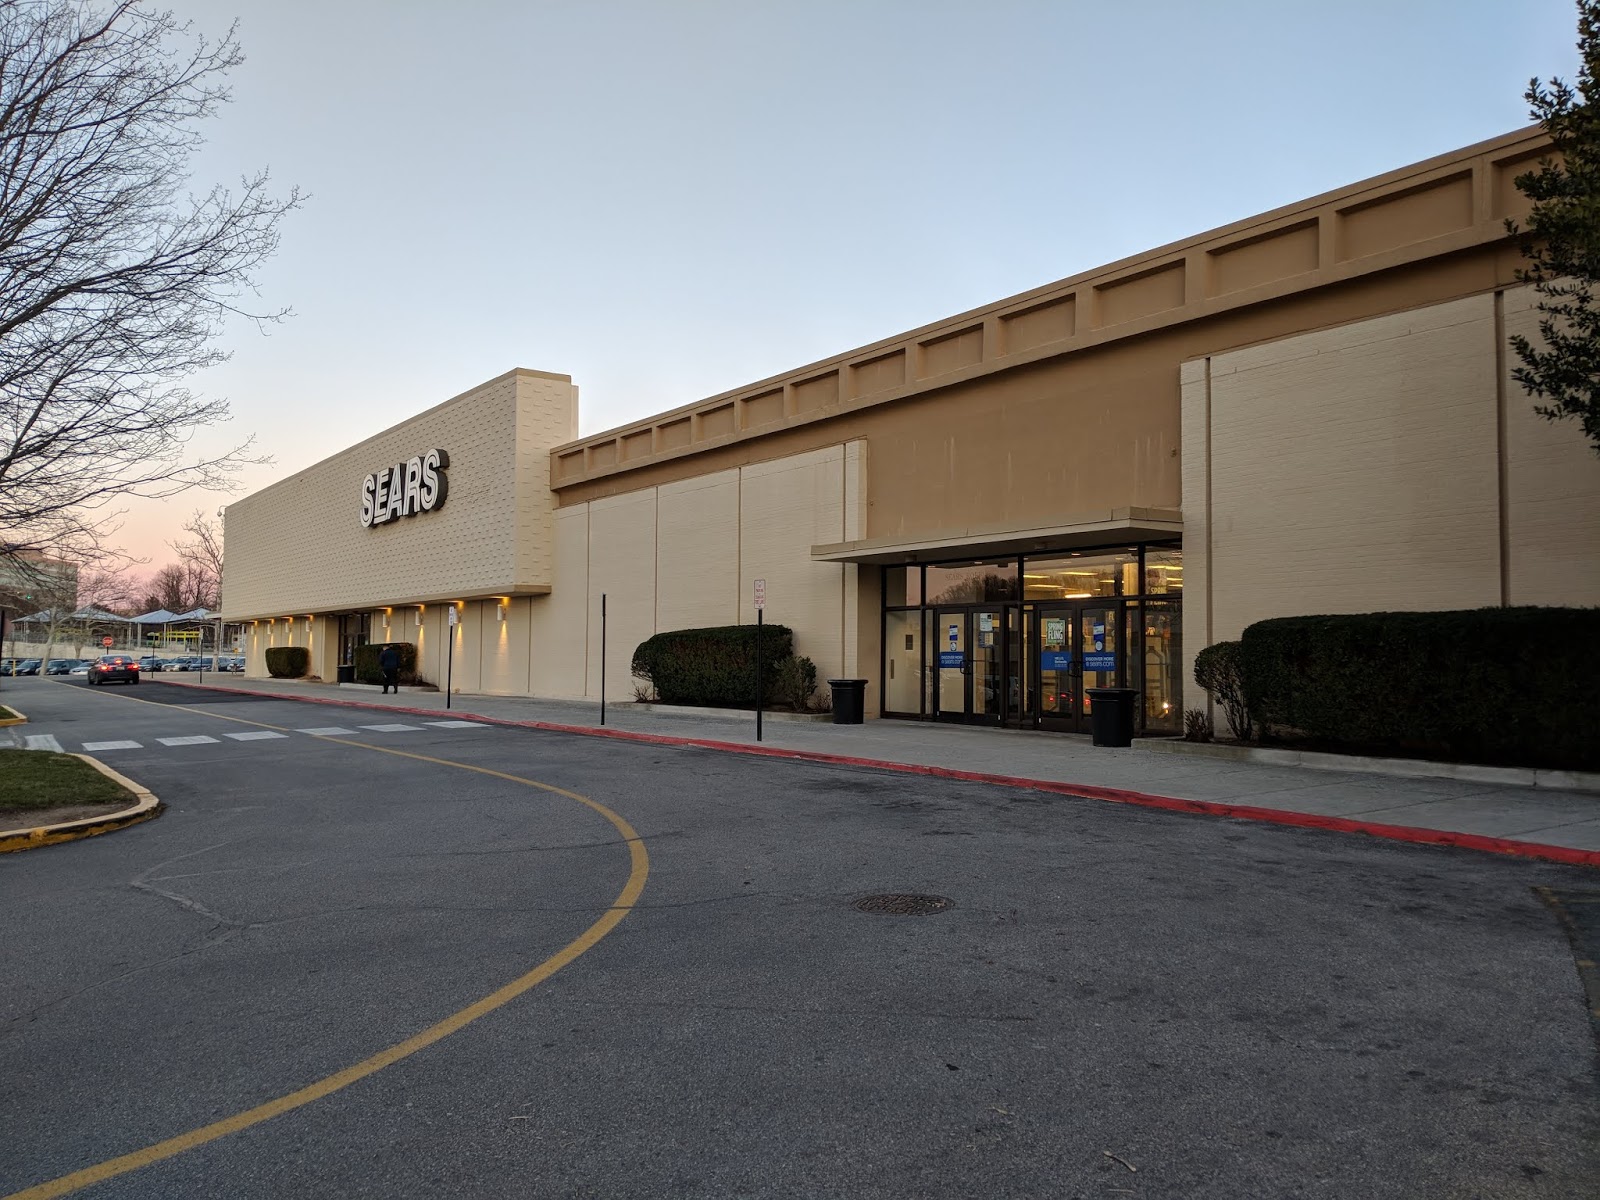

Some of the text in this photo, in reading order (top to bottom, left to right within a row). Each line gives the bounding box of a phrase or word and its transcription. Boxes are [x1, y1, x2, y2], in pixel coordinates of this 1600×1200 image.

[360, 448, 449, 528] SEARS
[1047, 622, 1063, 631] SPRING
[1047, 631, 1063, 640] FLING
